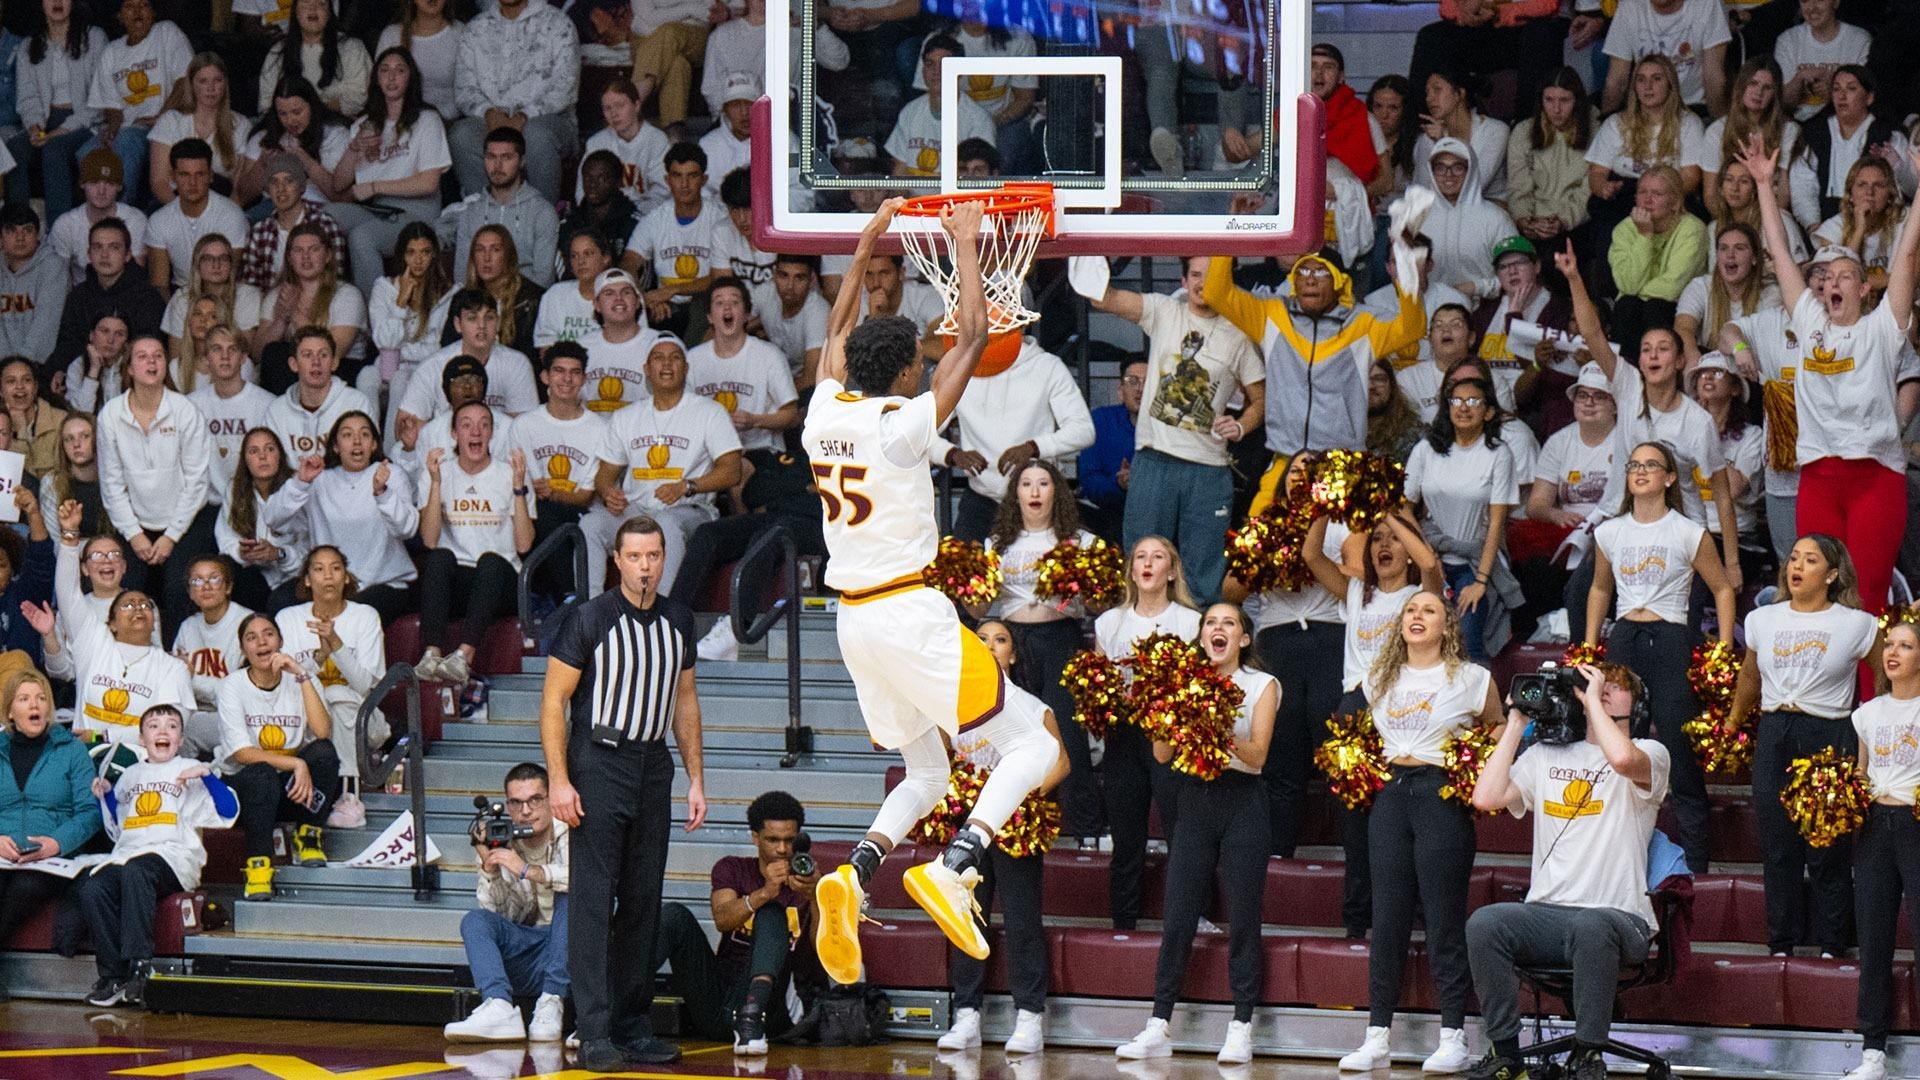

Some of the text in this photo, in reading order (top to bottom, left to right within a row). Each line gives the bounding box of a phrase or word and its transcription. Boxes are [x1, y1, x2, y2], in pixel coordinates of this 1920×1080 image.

[1242, 222, 1277, 231] DRAPER
[564, 316, 590, 328] FULL
[207, 418, 249, 435] ONA
[288, 433, 329, 452] ION
[820, 439, 855, 459] SHEMA
[812, 461, 873, 527] 55
[453, 499, 492, 512] IONA
[1549, 766, 1578, 781] GAEL
[146, 782, 183, 799] NATION
